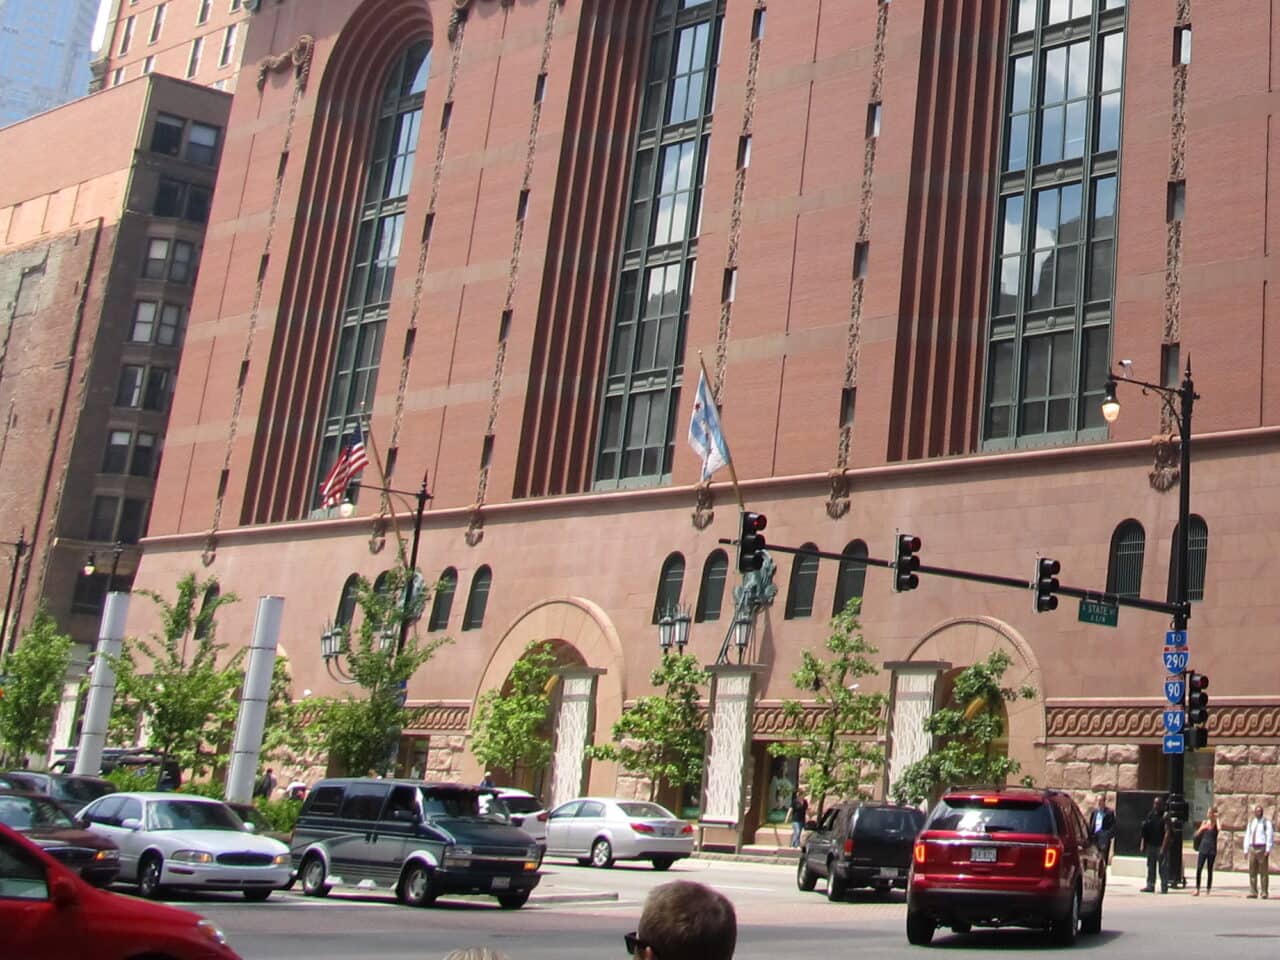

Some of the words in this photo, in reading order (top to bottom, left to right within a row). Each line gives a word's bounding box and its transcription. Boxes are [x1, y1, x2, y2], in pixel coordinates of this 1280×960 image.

[1088, 604, 1109, 616] STATE
[1171, 634, 1181, 642] TO
[1166, 654, 1185, 668] 290
[1167, 683, 1180, 697] 90
[1167, 713, 1180, 727] 94
